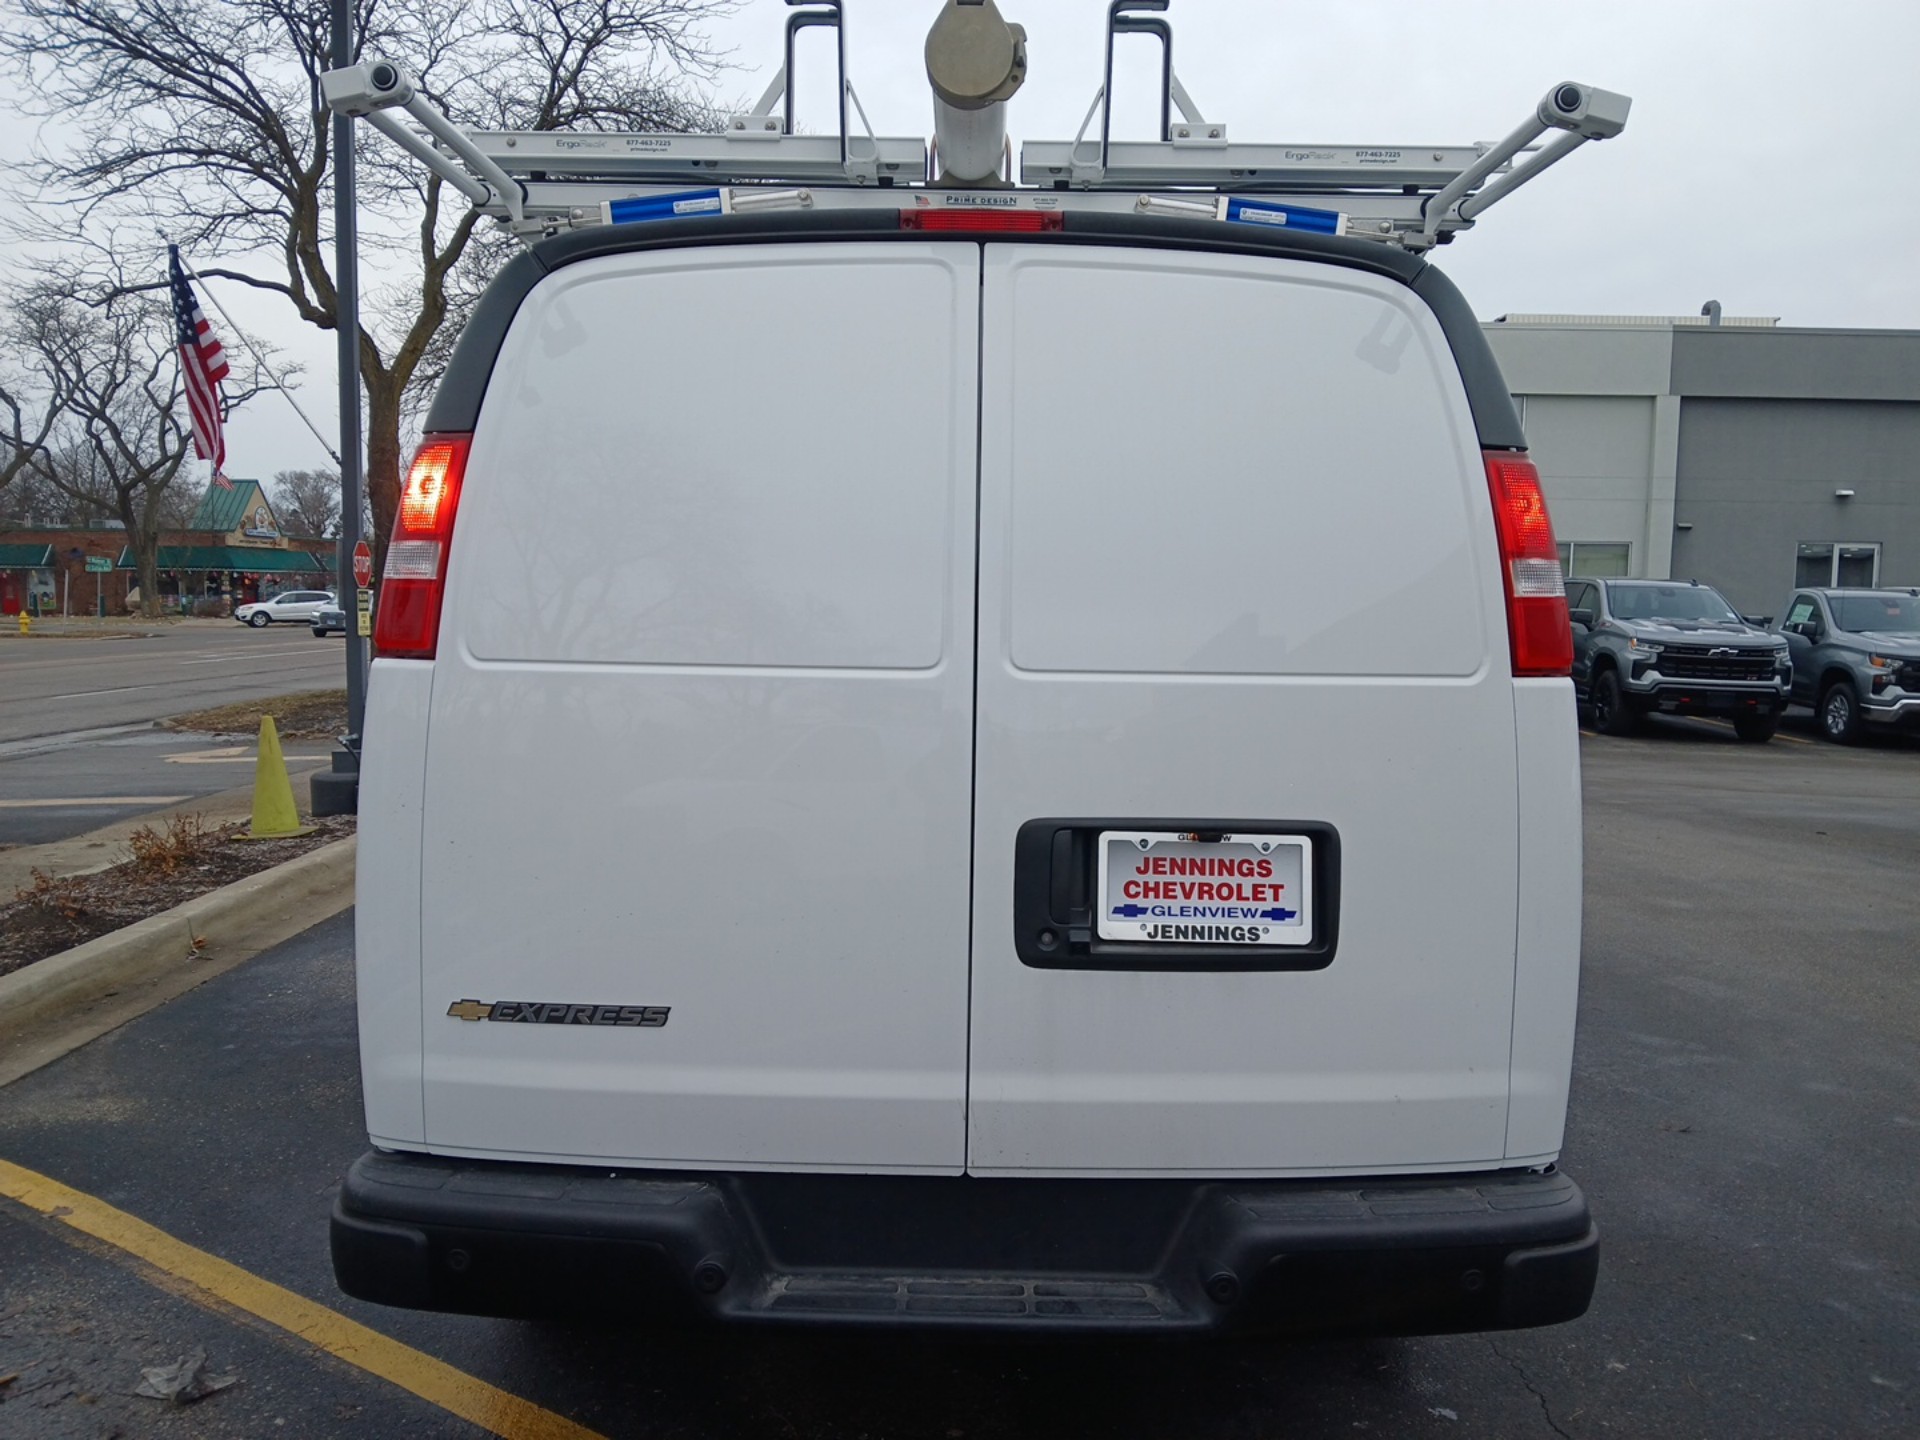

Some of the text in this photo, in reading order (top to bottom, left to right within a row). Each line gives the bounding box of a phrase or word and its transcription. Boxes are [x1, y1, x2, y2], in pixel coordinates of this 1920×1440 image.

[354, 556, 370, 573] STOP
[1135, 857, 1273, 878] JENNINGS
[1123, 880, 1285, 902] CHEVROLET
[1151, 905, 1260, 919] GLENVIEW
[1147, 924, 1261, 942] JENNINGS
[491, 1001, 671, 1027] EXPRESS
